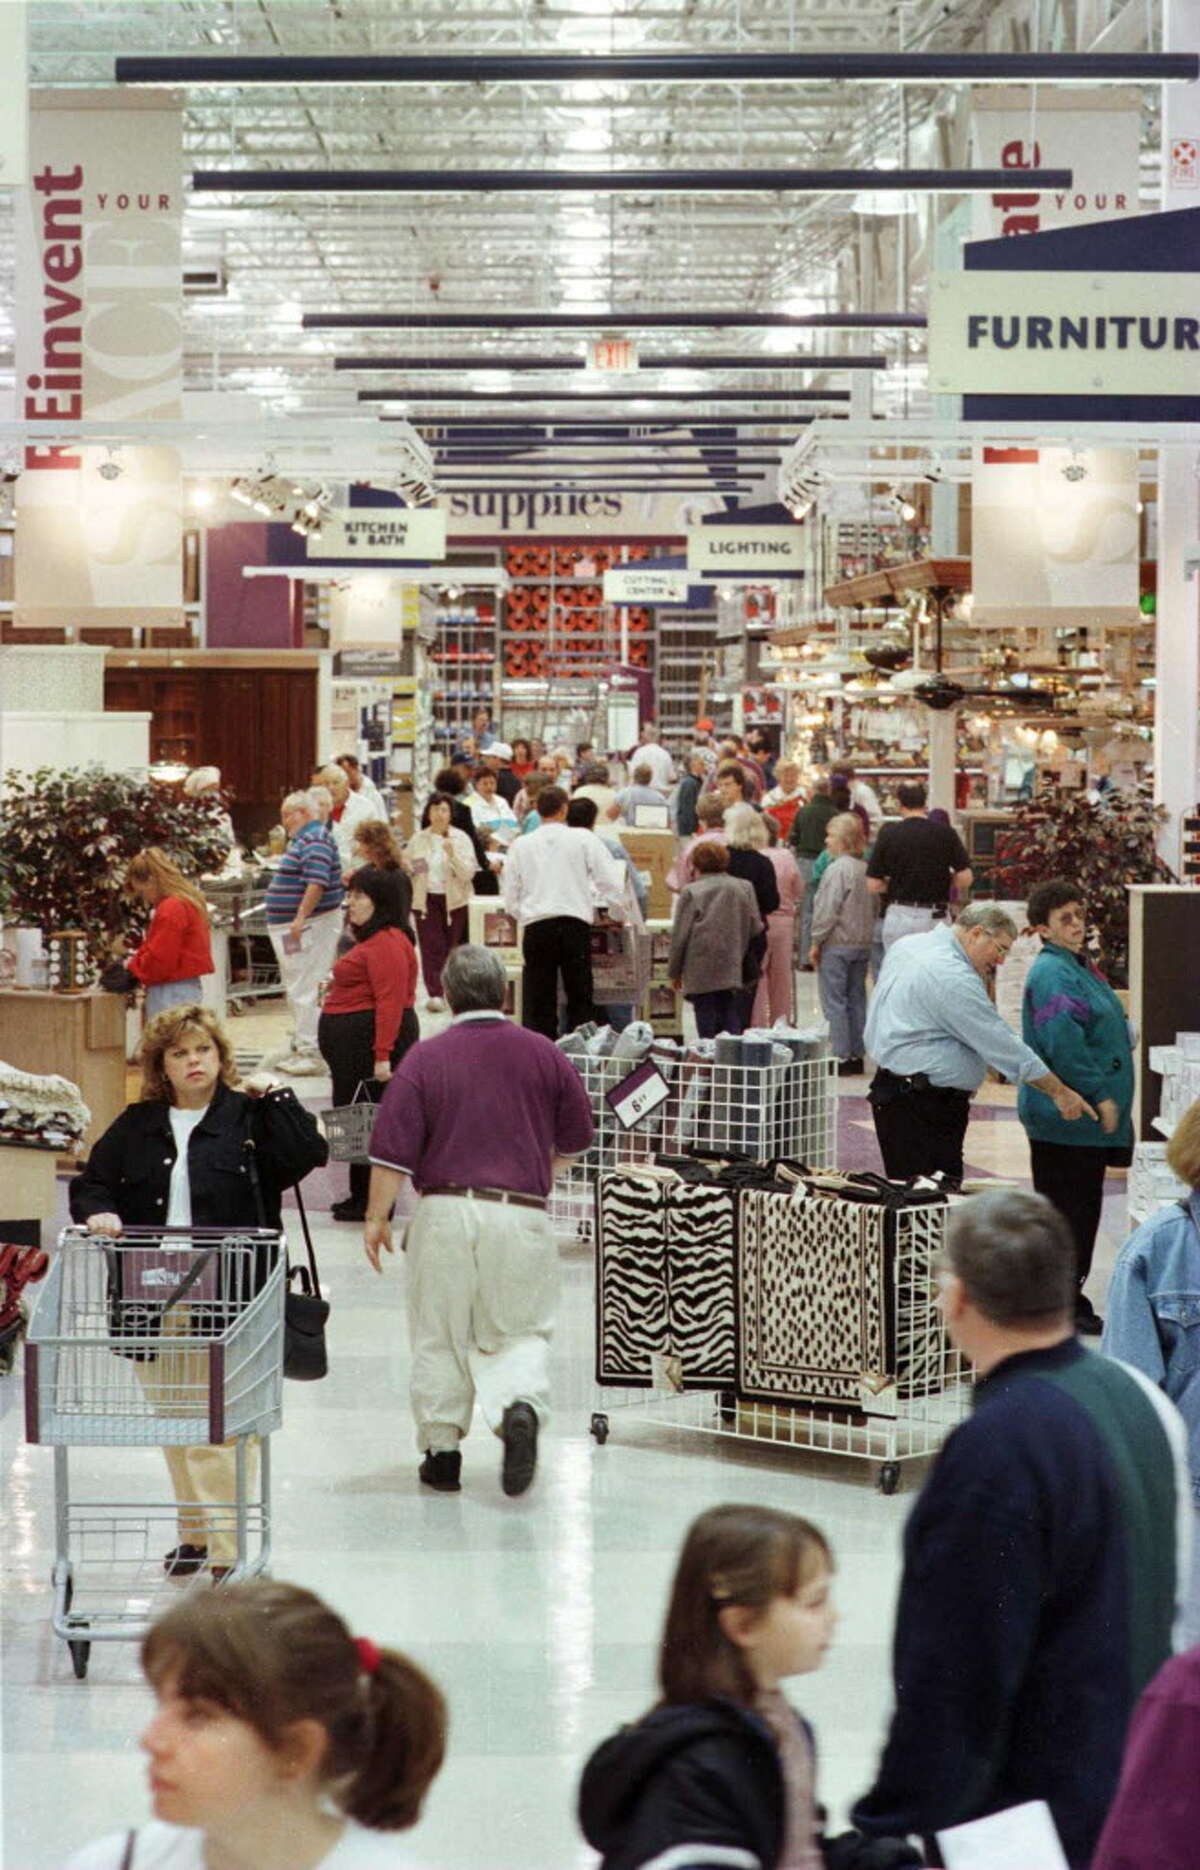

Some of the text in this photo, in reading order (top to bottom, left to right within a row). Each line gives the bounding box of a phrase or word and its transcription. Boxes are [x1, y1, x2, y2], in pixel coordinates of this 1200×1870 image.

[97, 193, 171, 210] YOUR
[1054, 193, 1128, 210] YOUR
[967, 315, 1200, 351] FURNITUR
[593, 341, 633, 369] EXIT
[450, 482, 623, 529] supplies
[344, 522, 408, 533] KITCHEN
[367, 534, 406, 545] BATH
[708, 541, 793, 555] LIGHTING
